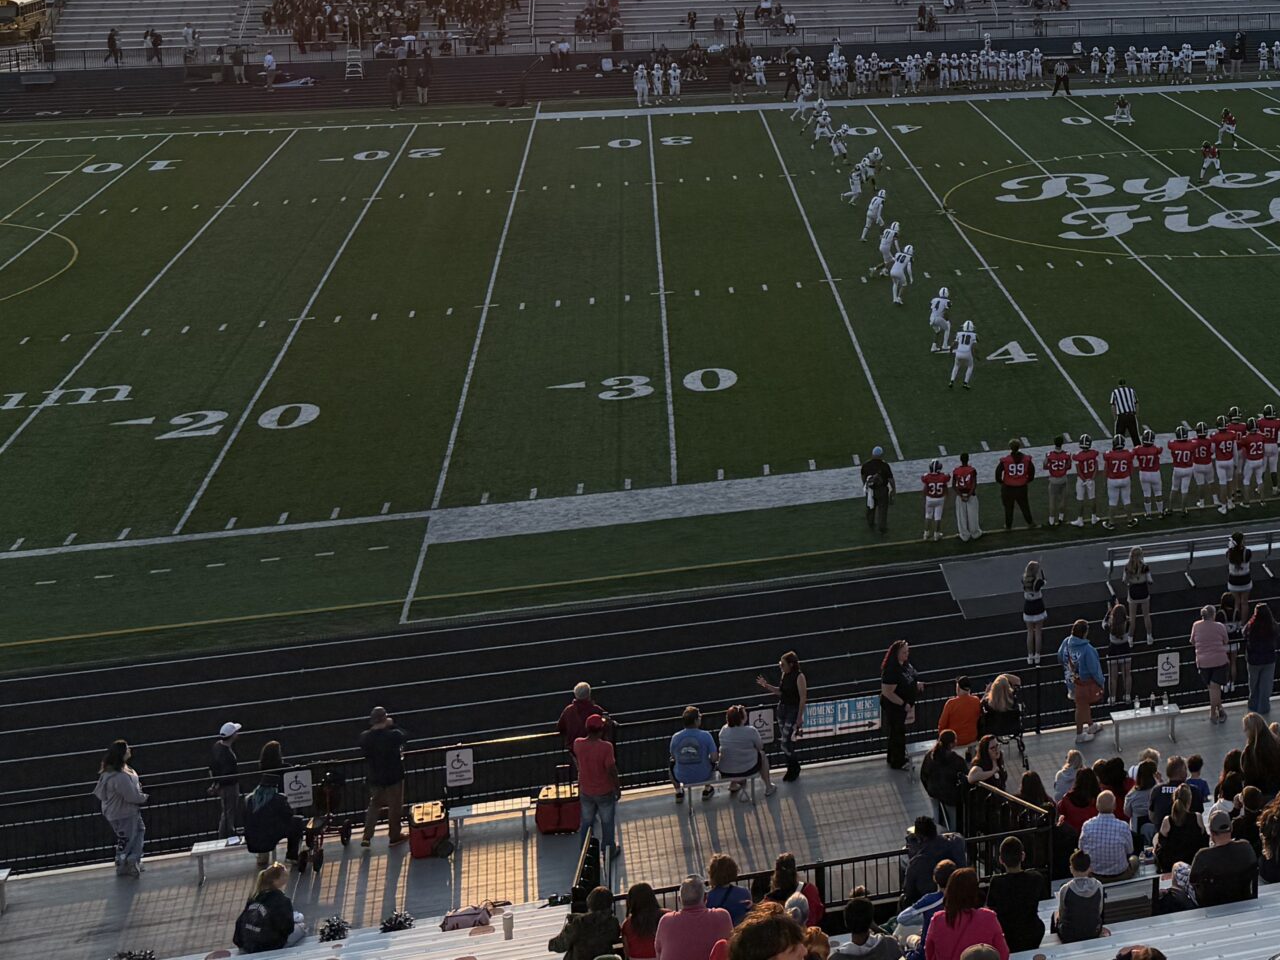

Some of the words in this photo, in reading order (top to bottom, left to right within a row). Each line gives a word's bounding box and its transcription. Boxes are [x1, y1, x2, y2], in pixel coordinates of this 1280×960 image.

[986, 335, 1109, 364] 40
[598, 367, 738, 400] 30
[155, 403, 321, 440] 20
[1218, 441, 1233, 453] 49
[1249, 441, 1264, 454] 23
[1139, 455, 1154, 467] 77
[1174, 450, 1191, 463] 70
[1008, 463, 1025, 476] 99
[1083, 459, 1095, 473] 13
[1112, 460, 1127, 473] 76
[928, 483, 944, 495] 35
